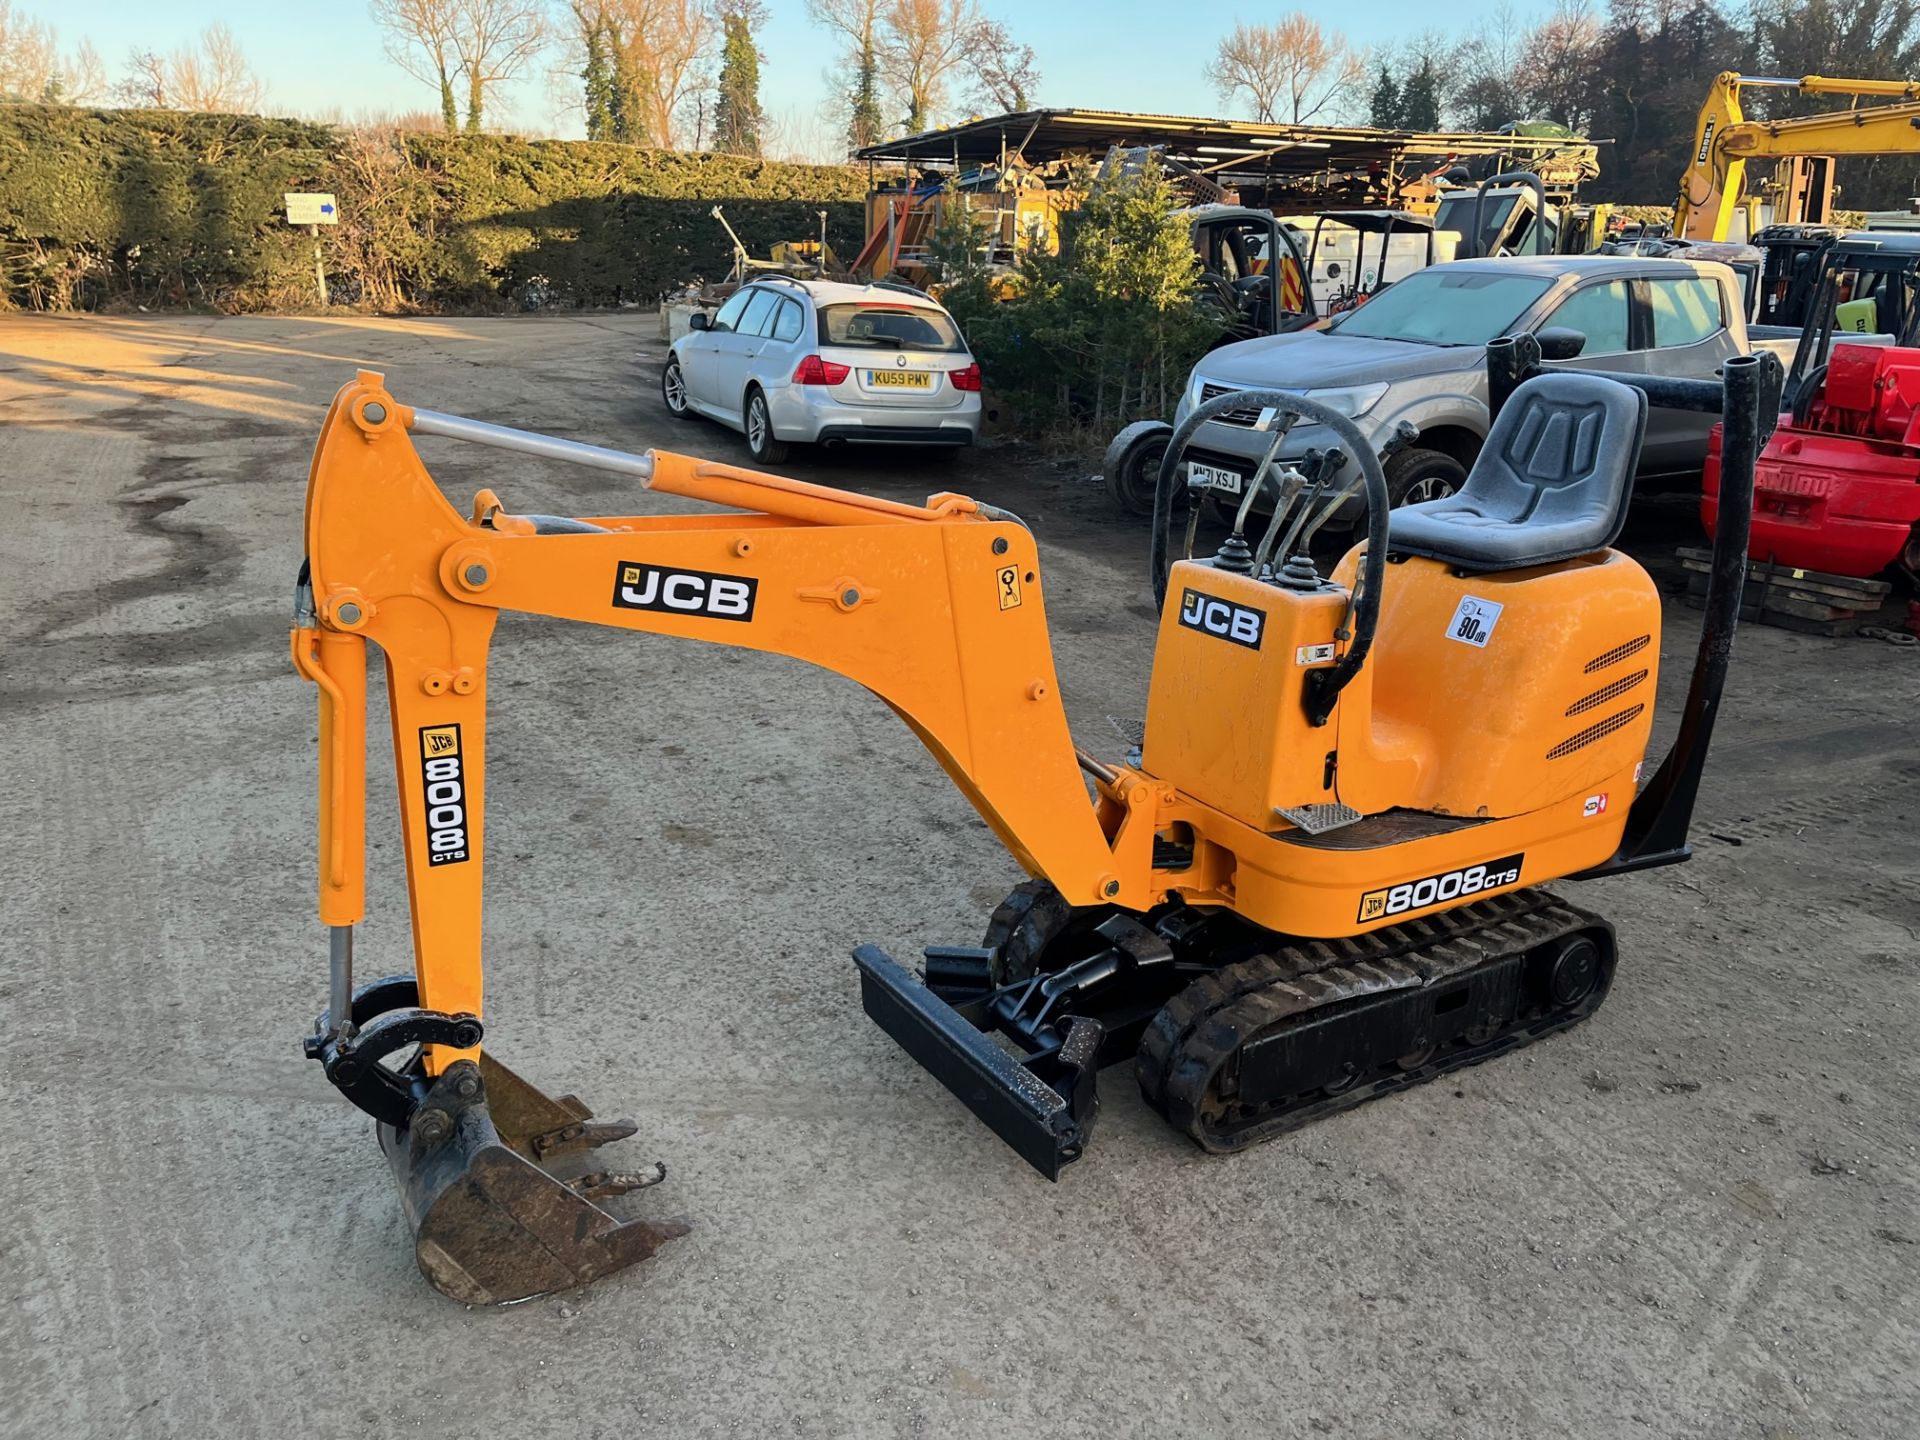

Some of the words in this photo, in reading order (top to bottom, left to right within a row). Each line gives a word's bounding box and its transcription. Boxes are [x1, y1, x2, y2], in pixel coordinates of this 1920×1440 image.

[875, 372, 905, 385] KU59
[908, 373, 929, 386] PMY
[1215, 470, 1235, 489] XSJ
[621, 570, 750, 615] JCB
[1183, 597, 1260, 643] JCB
[431, 734, 453, 752] JCB
[425, 757, 465, 852] 8008
[432, 850, 466, 862] CTS
[1366, 897, 1383, 913] JCB
